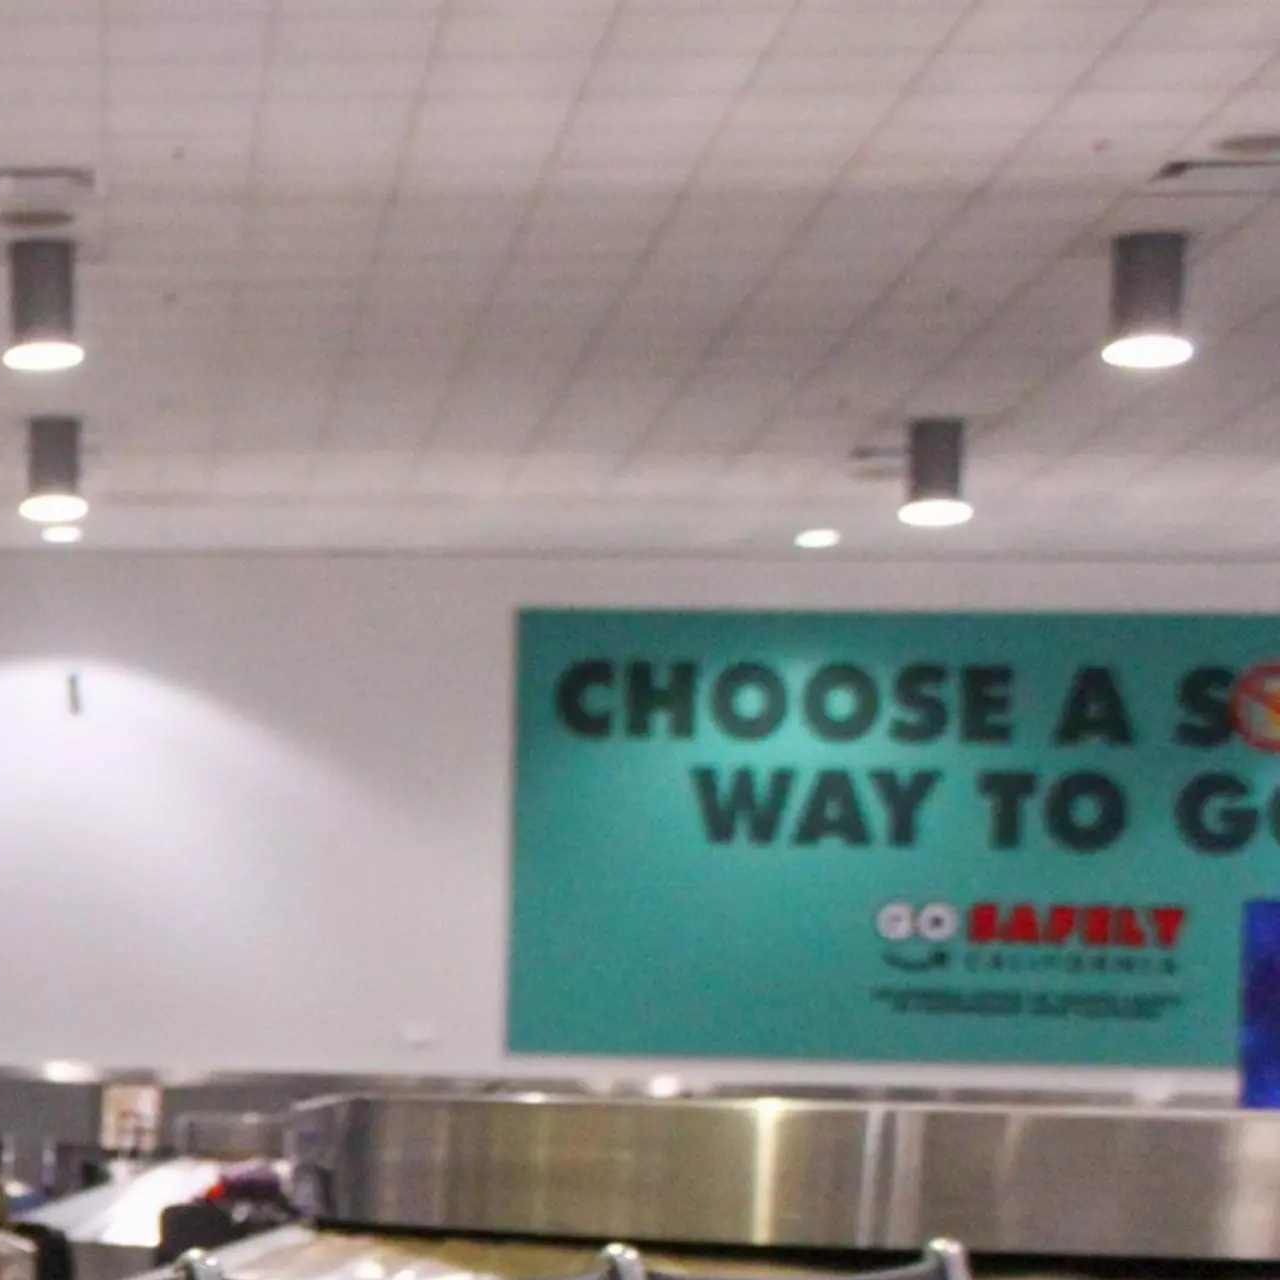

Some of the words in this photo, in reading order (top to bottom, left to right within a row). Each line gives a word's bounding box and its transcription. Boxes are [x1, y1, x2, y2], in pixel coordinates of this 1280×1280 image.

[555, 659, 1013, 742] CHOOSE
[1055, 664, 1133, 744] A
[690, 767, 941, 847] WAY
[978, 768, 1127, 855] TO
[1174, 772, 1280, 857] G
[876, 901, 958, 941] GO
[966, 902, 1185, 947] SAFELY
